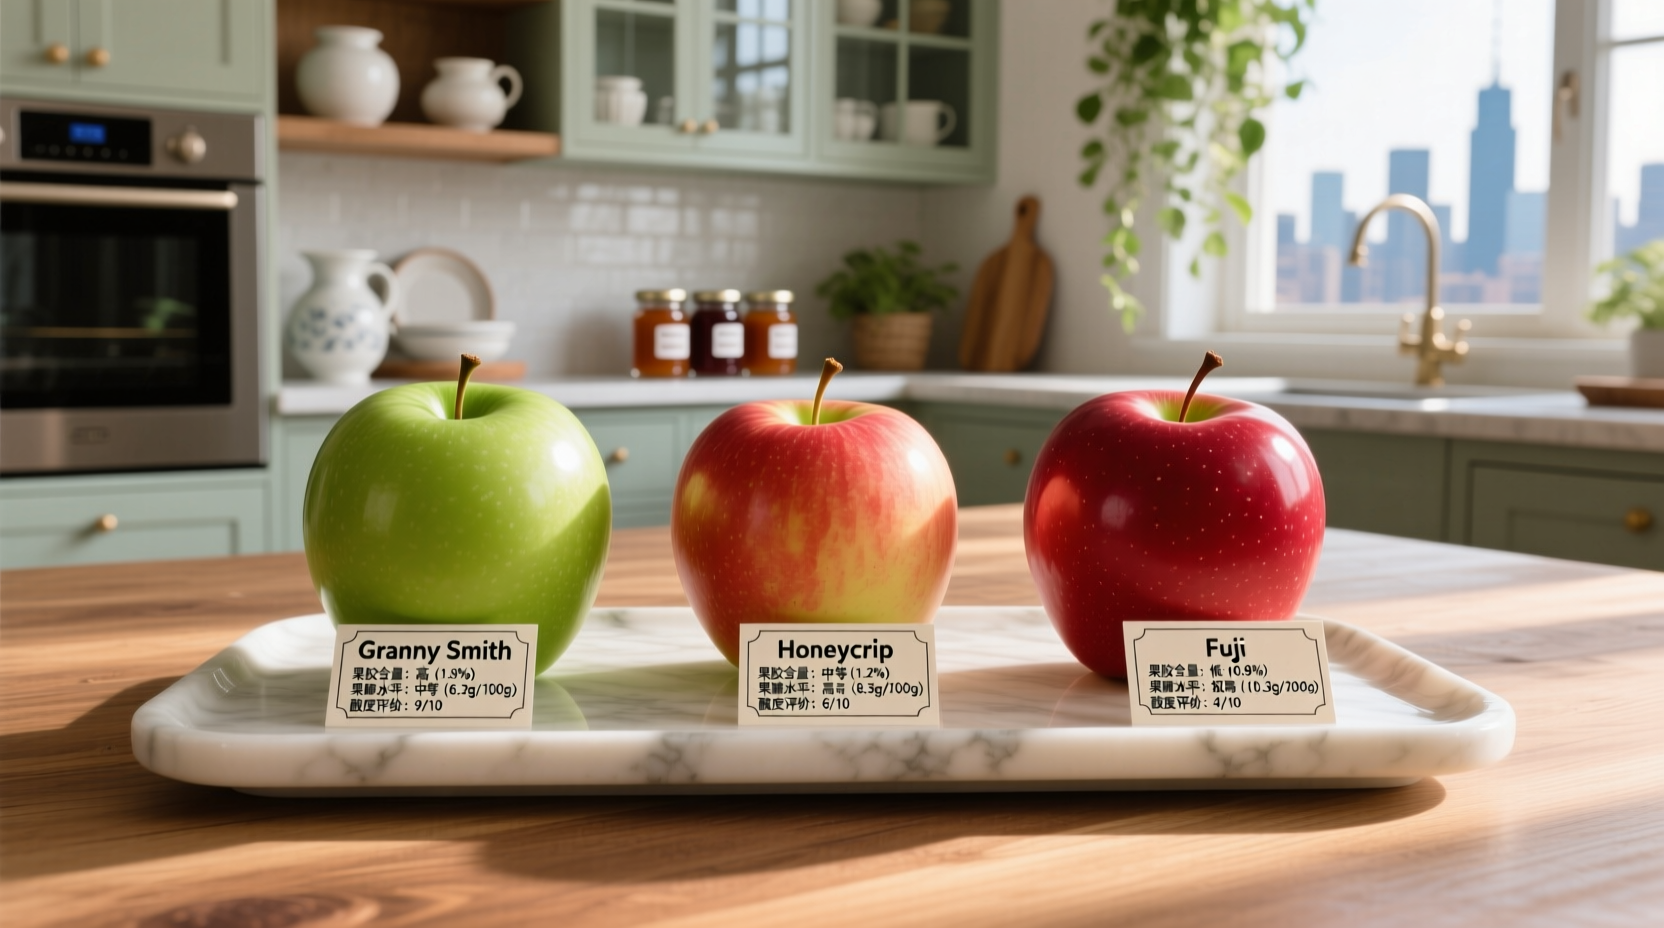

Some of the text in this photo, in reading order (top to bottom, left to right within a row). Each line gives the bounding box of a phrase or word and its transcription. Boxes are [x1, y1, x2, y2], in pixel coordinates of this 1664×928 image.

[359, 640, 511, 665] Granny Smith
[779, 638, 893, 664] Honeycrip
[1206, 637, 1245, 663] Fuji
[415, 700, 442, 711] 9/10
[822, 698, 849, 710] 6/10
